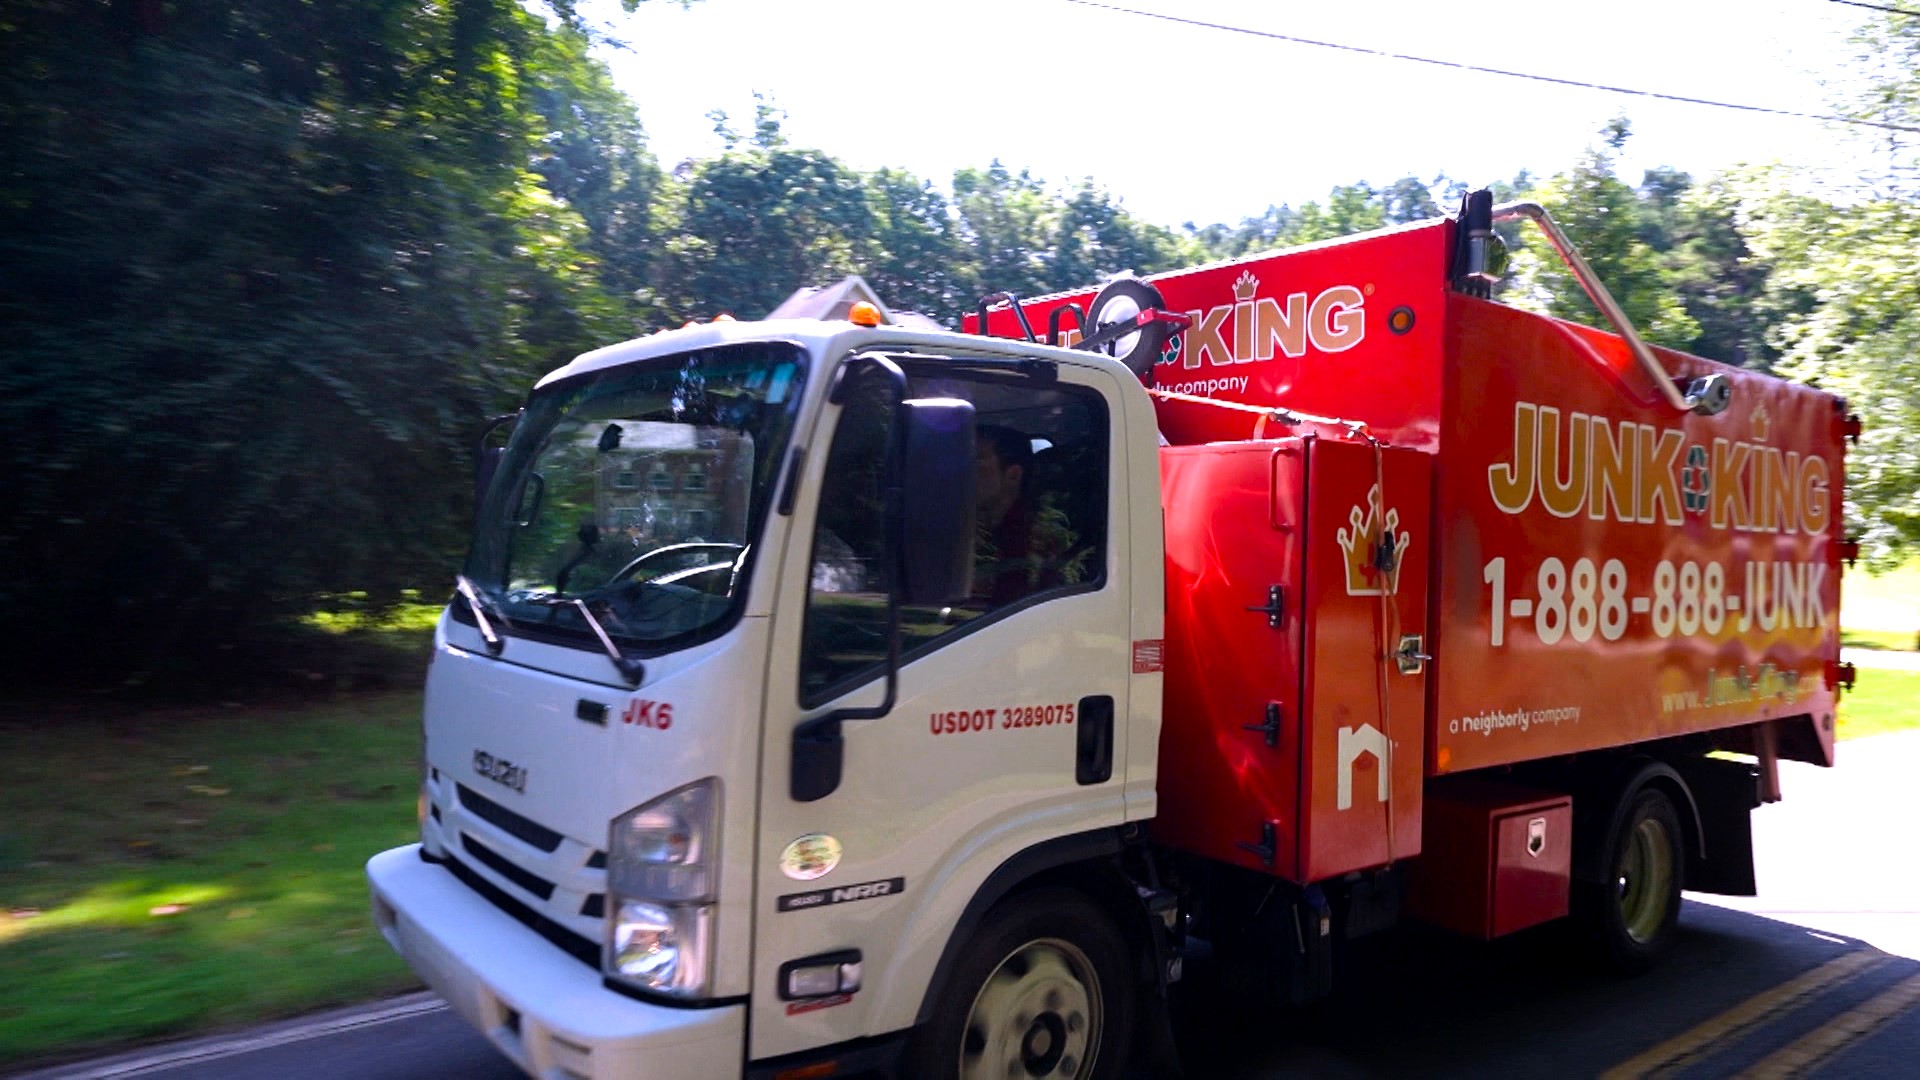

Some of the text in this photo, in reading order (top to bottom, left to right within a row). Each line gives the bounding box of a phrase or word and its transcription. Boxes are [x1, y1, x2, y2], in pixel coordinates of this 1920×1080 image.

[1183, 284, 1366, 369] KING
[1174, 375, 1249, 399] company
[1488, 400, 1830, 536] JUNK KING
[1483, 556, 1829, 647] 1-888-888-JUNK
[622, 698, 673, 730] JK6
[930, 703, 1075, 735] USDOT 3289075
[1449, 706, 1581, 736] a neighborly company
[473, 748, 527, 796] ISUZU
[831, 881, 892, 903] NRR
